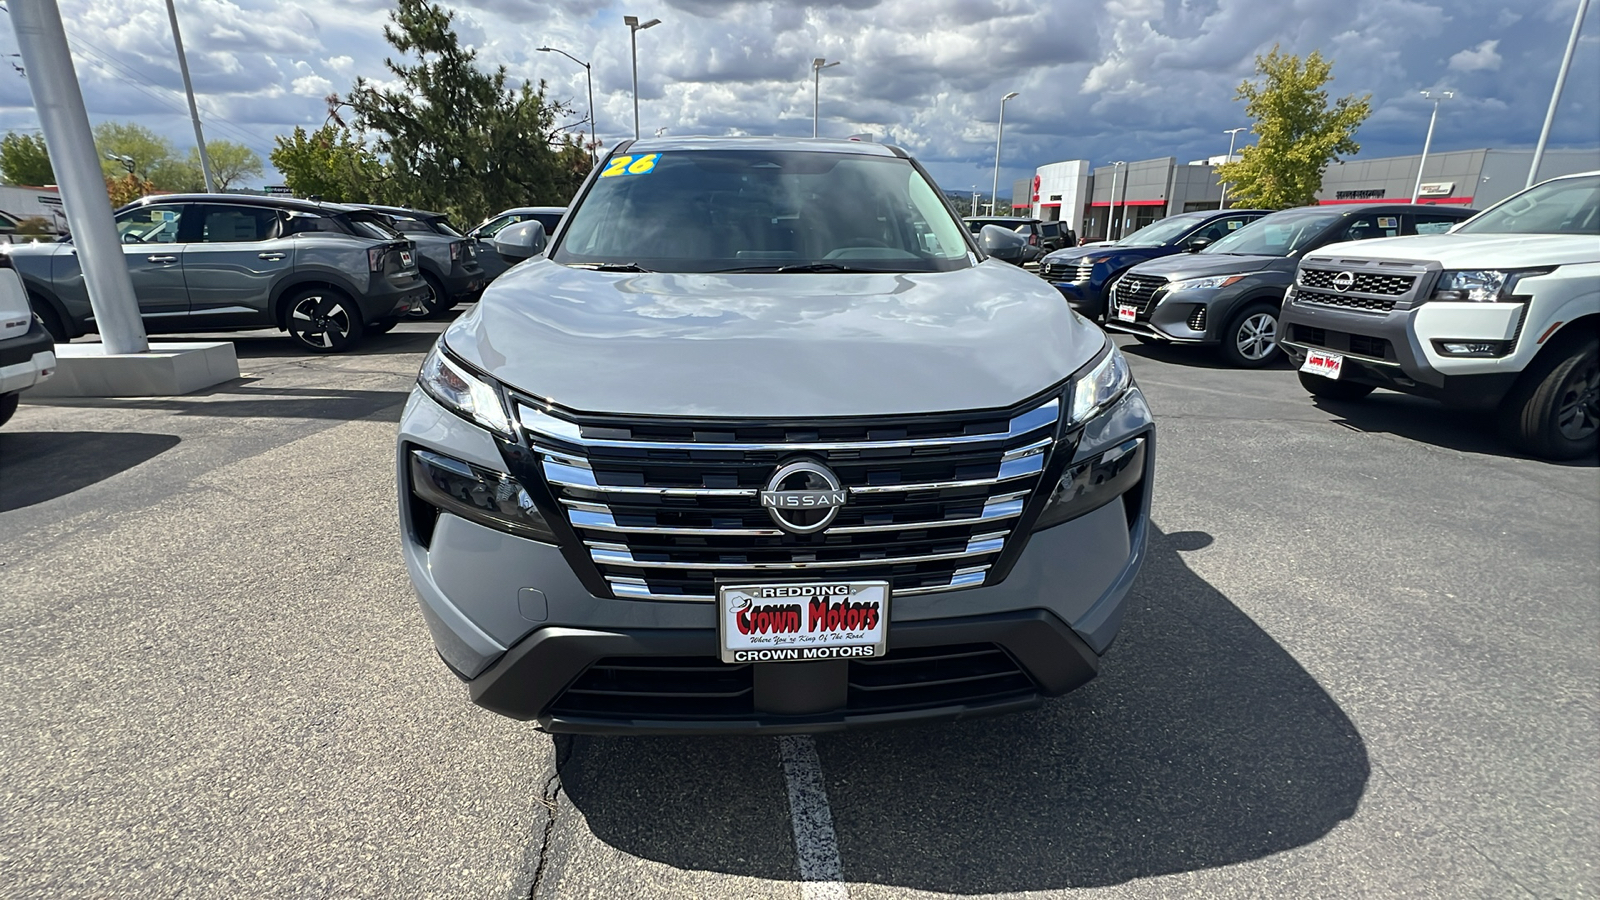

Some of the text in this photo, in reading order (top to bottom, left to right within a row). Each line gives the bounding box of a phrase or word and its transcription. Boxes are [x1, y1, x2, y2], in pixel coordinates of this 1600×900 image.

[601, 153, 657, 177] 26
[763, 492, 845, 506] NISSAN
[762, 586, 848, 597] REDDING
[736, 596, 879, 635] Crown Motors
[773, 635, 796, 645] You're
[799, 635, 816, 643] King
[819, 633, 827, 642] Of
[830, 632, 842, 640] The
[735, 646, 874, 661] CROWN MOTORS
